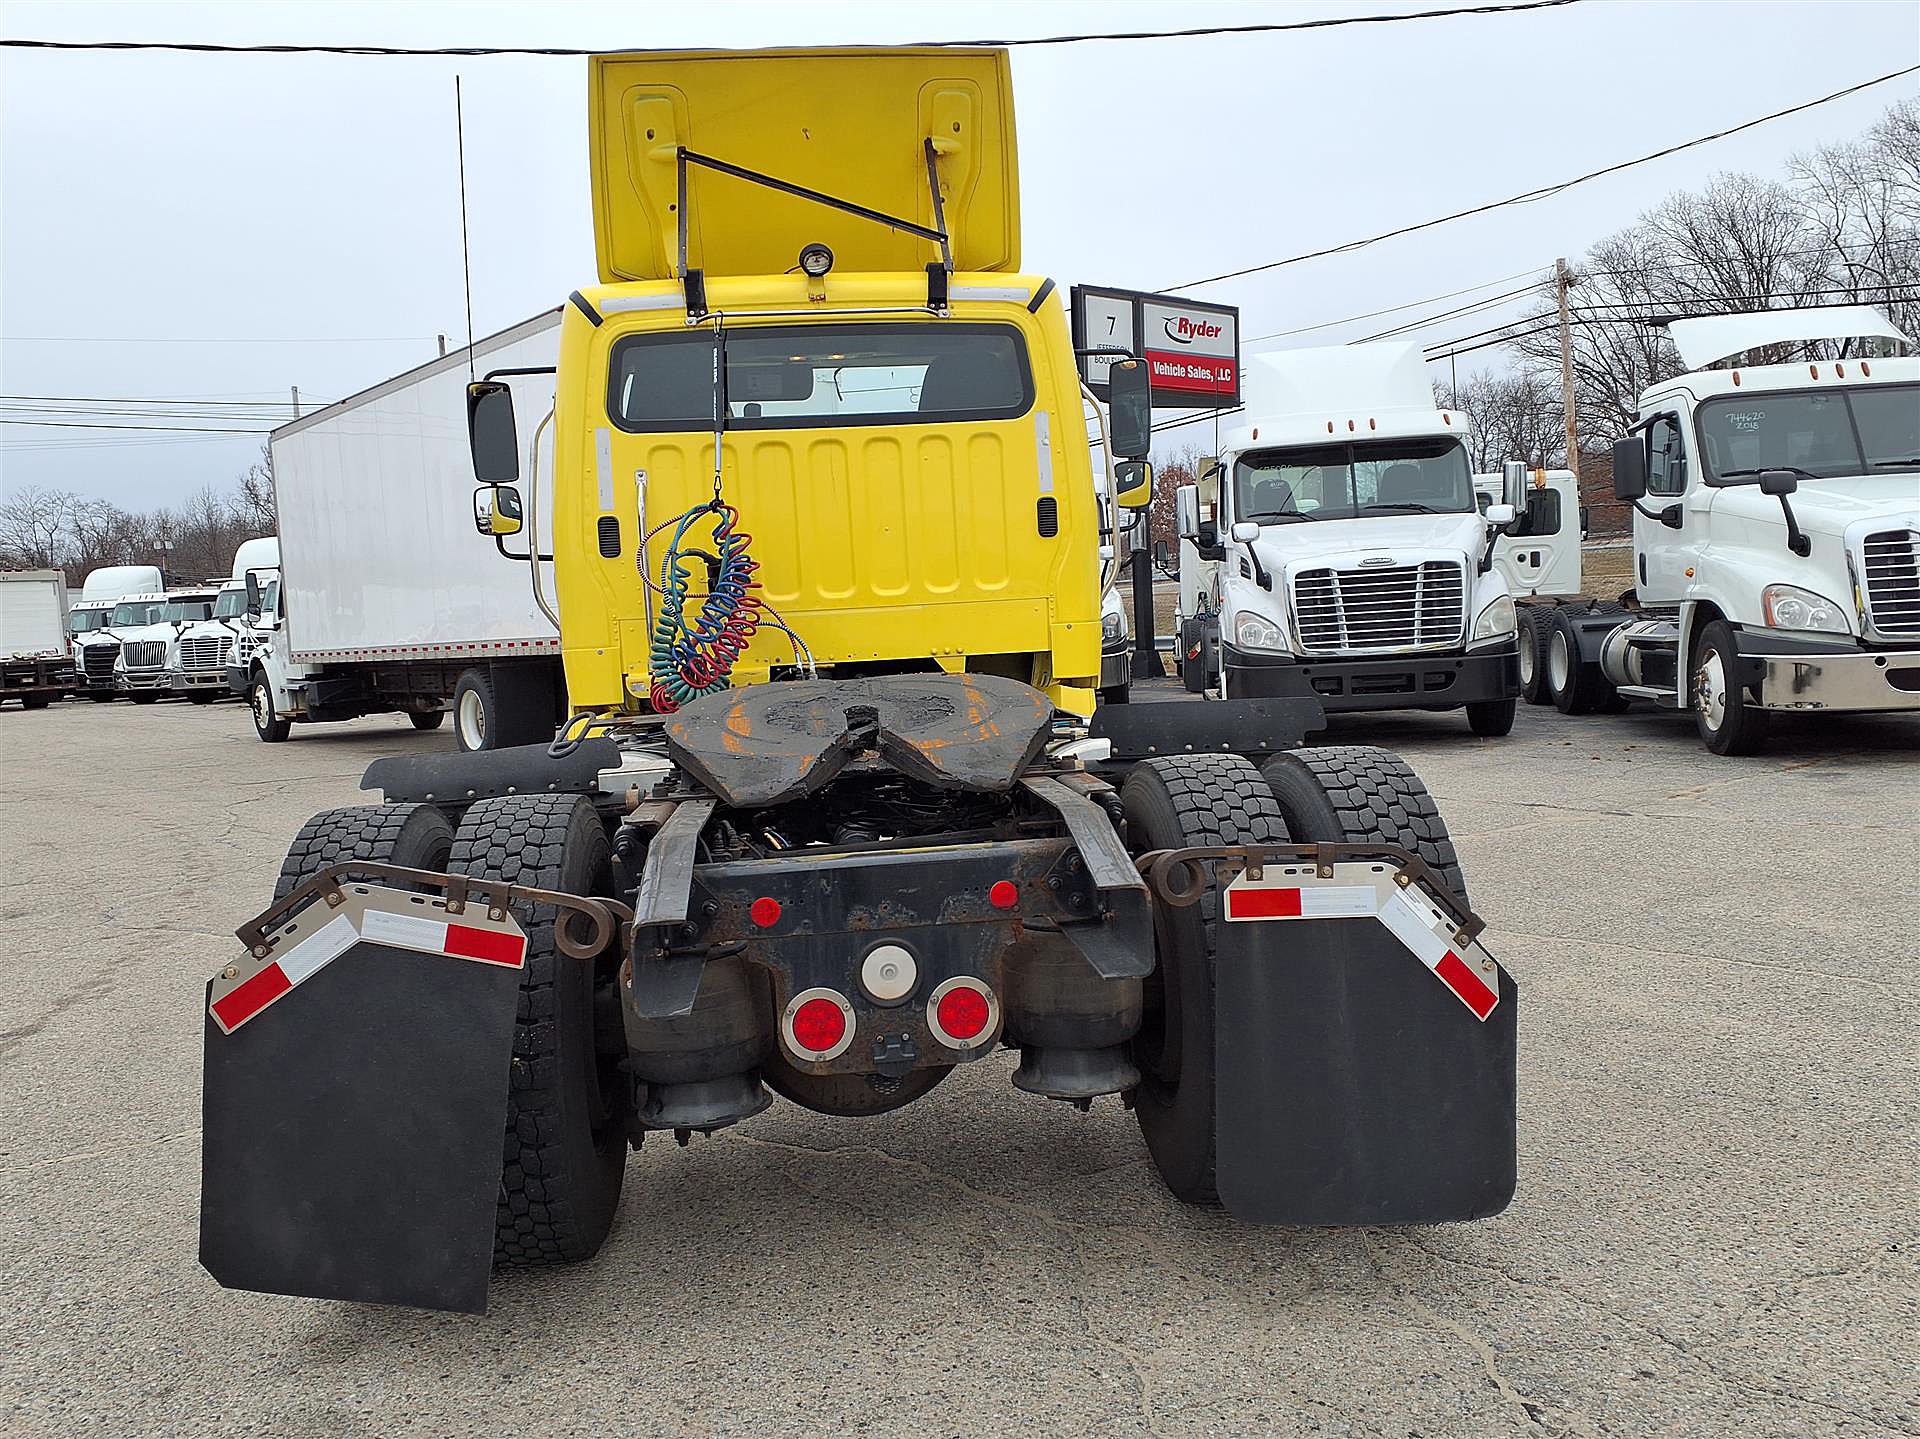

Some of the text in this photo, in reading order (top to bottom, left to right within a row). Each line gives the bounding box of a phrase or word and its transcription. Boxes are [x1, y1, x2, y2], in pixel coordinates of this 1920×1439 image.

[1106, 316, 1116, 336] 7
[1177, 317, 1222, 339] Ryder
[1153, 361, 1186, 377] Vehicle
[1187, 364, 1214, 382] Sales,
